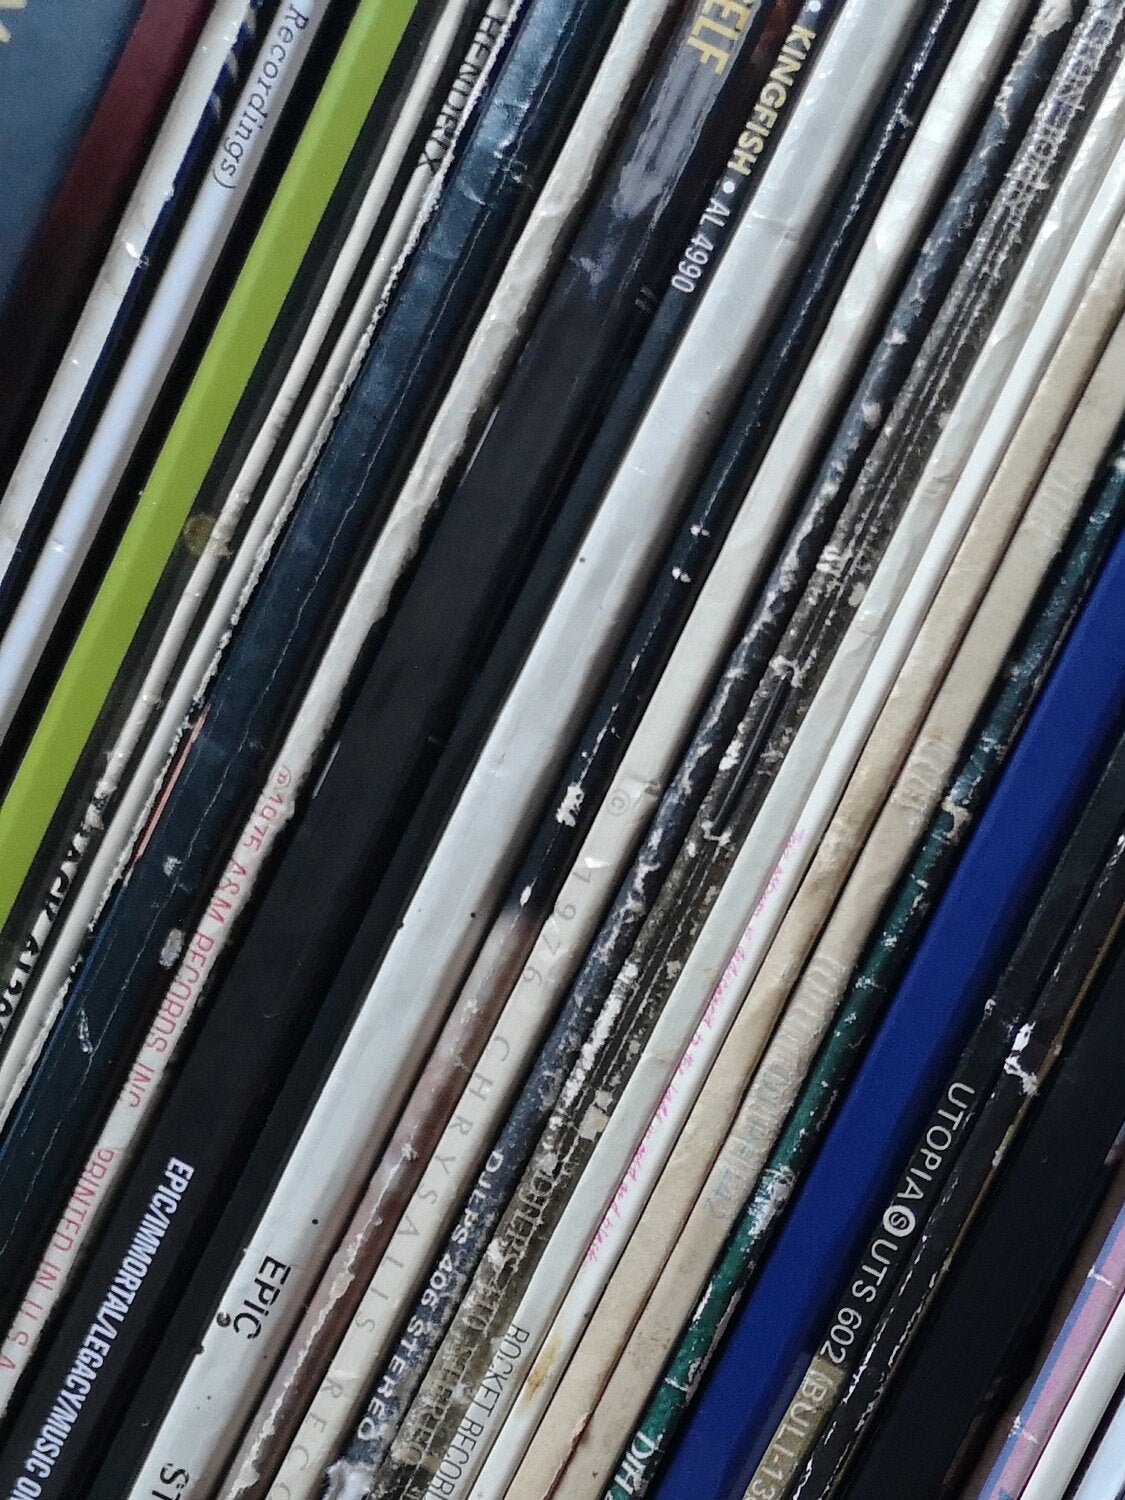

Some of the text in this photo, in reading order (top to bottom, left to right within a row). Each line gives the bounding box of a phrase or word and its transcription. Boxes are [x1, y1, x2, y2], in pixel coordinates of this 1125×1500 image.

[208, 4, 313, 194] Recordings)
[667, 21, 816, 297] KINGFISH AL 4990
[518, 863, 593, 990] 1976
[353, 1033, 512, 1335] CHRYSALIS
[892, 1078, 975, 1208] UTOPIA
[229, 1254, 290, 1344] EPIC
[352, 1149, 505, 1444] DJLPS 406 STEREO
[846, 1233, 899, 1304] UTS
[468, 1323, 529, 1418] ROCKET
[817, 1303, 864, 1365] 602
